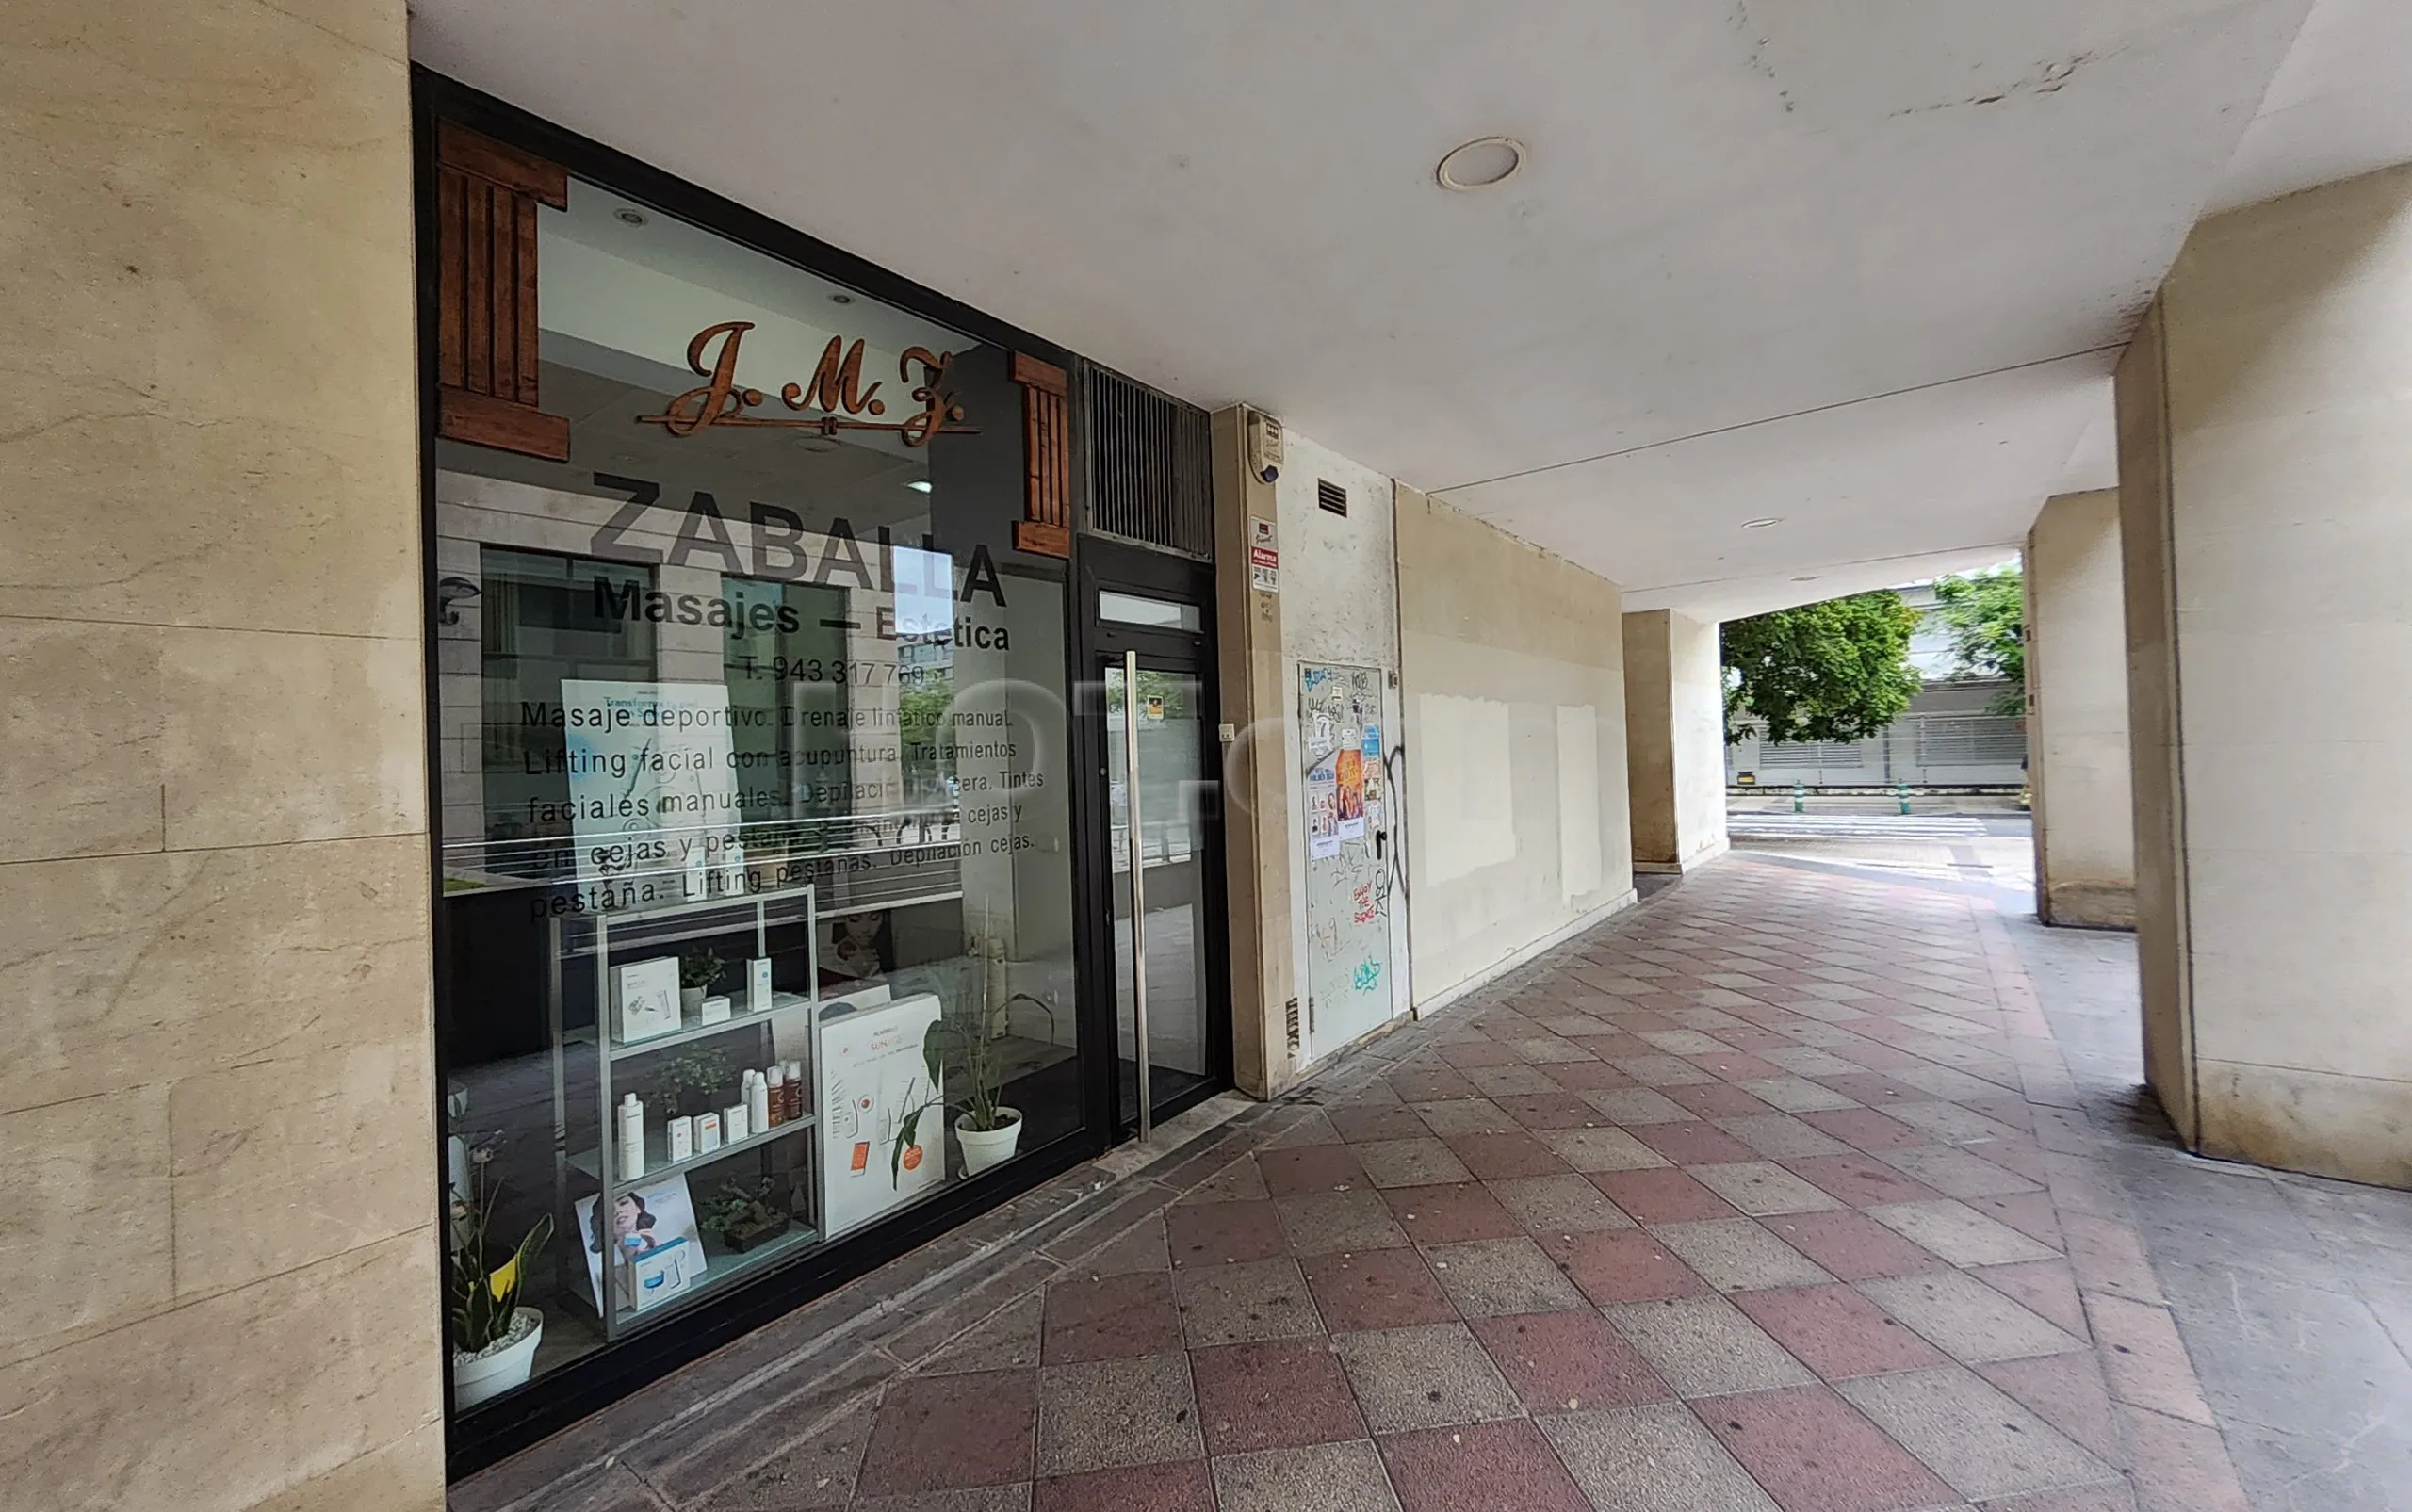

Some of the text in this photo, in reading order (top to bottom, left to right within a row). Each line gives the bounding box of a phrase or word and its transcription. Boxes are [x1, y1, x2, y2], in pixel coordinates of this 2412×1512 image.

[590, 471, 1007, 608] ZABALLA
[1253, 548, 1278, 564] Alarma
[594, 576, 801, 640] Masajes
[773, 655, 823, 682] 943
[831, 660, 876, 685] 317
[883, 663, 924, 687] 769
[519, 701, 630, 733] Masaje
[643, 704, 774, 733] deportivo.
[782, 706, 865, 731] Drenaje
[952, 709, 1013, 727] manual.
[523, 749, 626, 778] Lifting
[640, 745, 713, 772] facial
[726, 750, 768, 769] con
[909, 740, 1017, 762] Tratamientos
[528, 793, 650, 823] faciales
[998, 771, 1044, 789] Tintes
[968, 805, 1022, 826] cejas y
[590, 837, 666, 869] cejas
[679, 837, 693, 862] y
[530, 879, 665, 920] pestaña.
[683, 870, 762, 894] Lifting
[890, 837, 982, 868] Depilación
[991, 834, 1035, 855] cejas.
